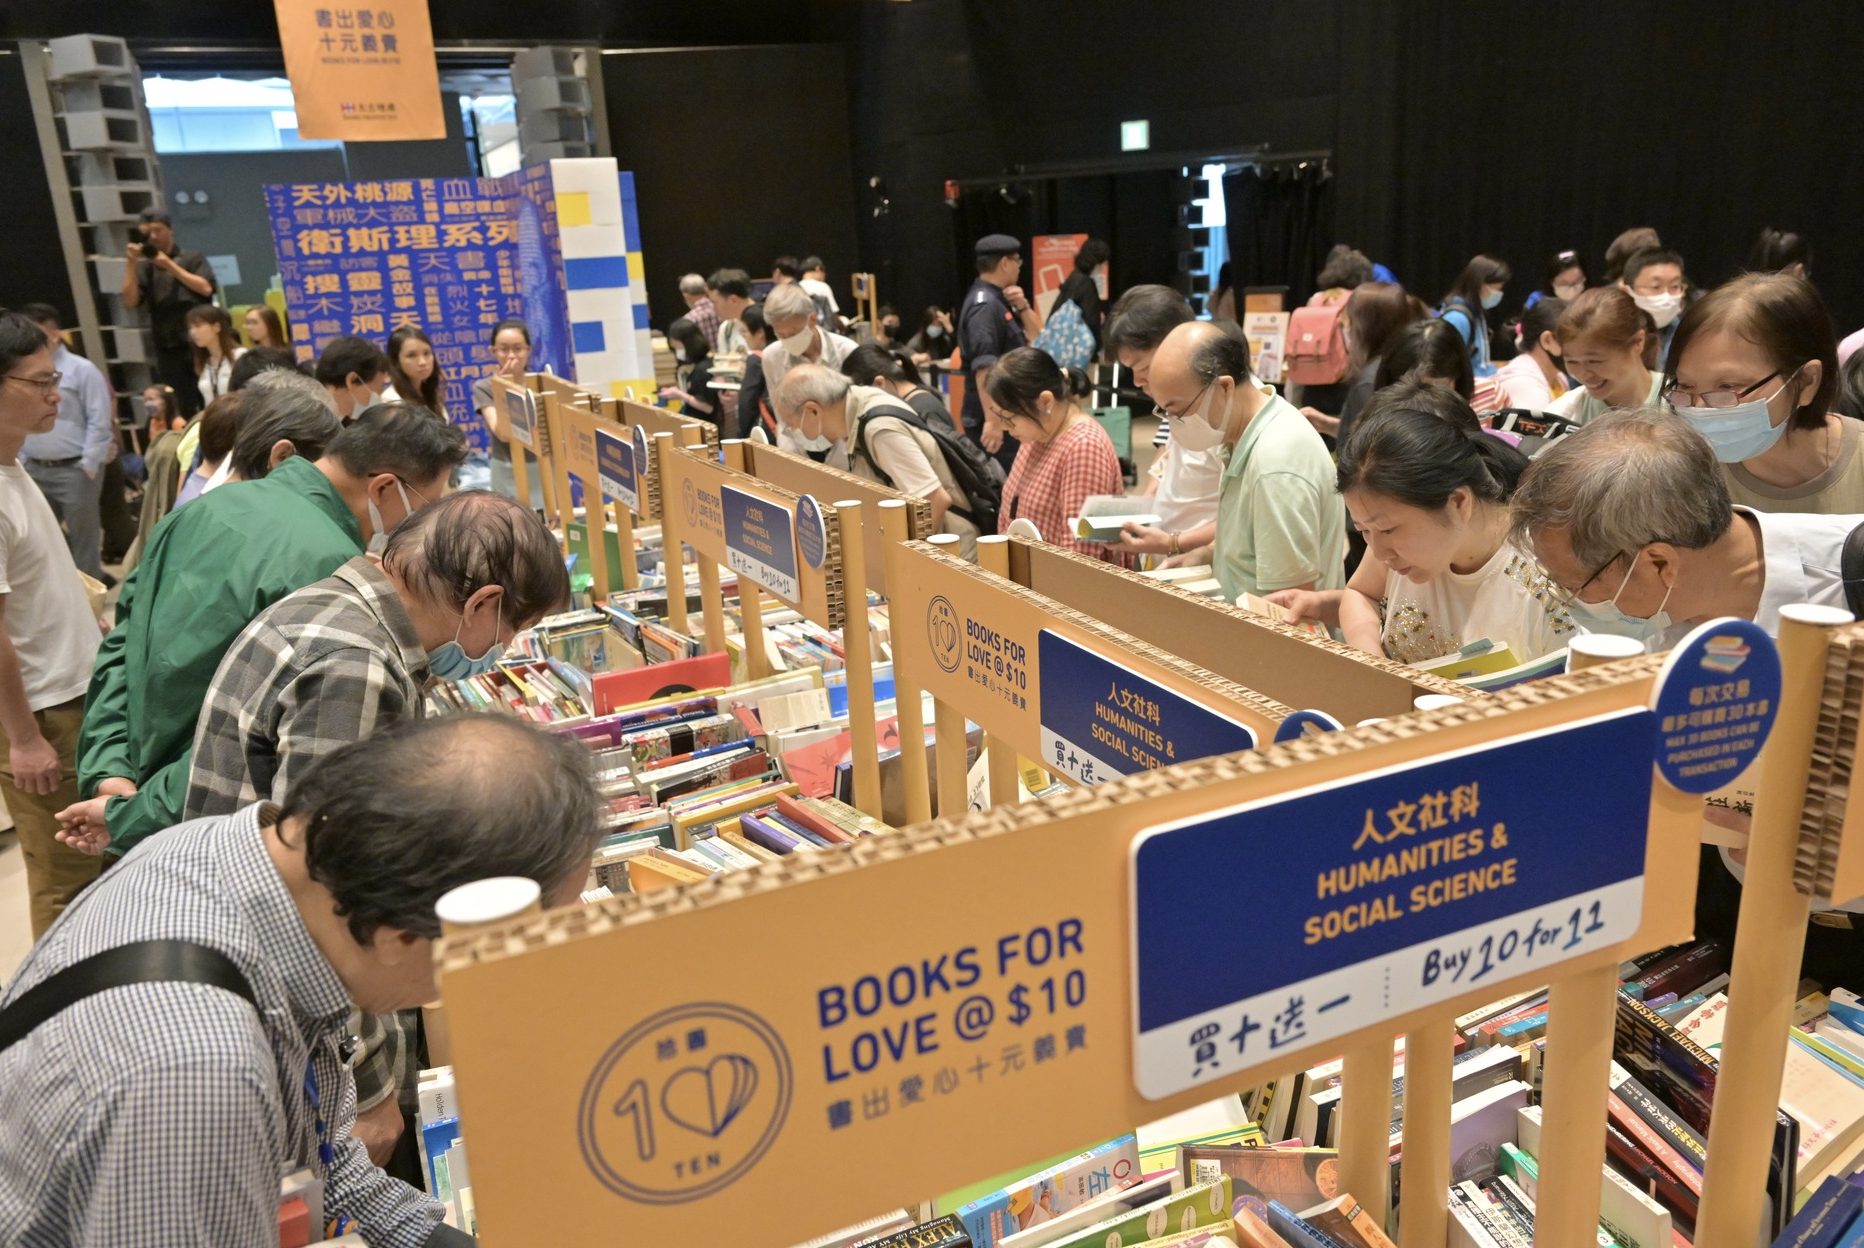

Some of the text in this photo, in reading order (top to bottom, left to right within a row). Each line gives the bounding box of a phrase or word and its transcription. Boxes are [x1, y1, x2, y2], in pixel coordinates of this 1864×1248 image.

[291, 181, 415, 206] 天外桃源
[296, 220, 519, 256] 衛斯理系列
[966, 617, 1026, 667] BOOKS FOR
[967, 641, 1026, 690] LOVE @ $10
[1107, 681, 1161, 727] 人文社科
[1091, 723, 1166, 771] SOCIAL SCIEN
[1095, 701, 1175, 759] HUMANITIES &
[1351, 781, 1481, 851] 人文社科
[1317, 822, 1508, 900] HUMANITIES &
[1304, 858, 1518, 946] SOCIAL SCIENCE
[1421, 900, 1606, 986] Buy 10 for 11
[817, 917, 1084, 1029] BOOKS FOR
[822, 969, 1086, 1084] LOVE @ $10
[1187, 993, 1352, 1077] 買十送一
[1627, 999, 1671, 1032] JACKSON
[1668, 1030, 1714, 1064] MICHAEL
[673, 1152, 721, 1179] TEN
[911, 1221, 960, 1248] ALEX
[920, 1216, 952, 1231] Managing
